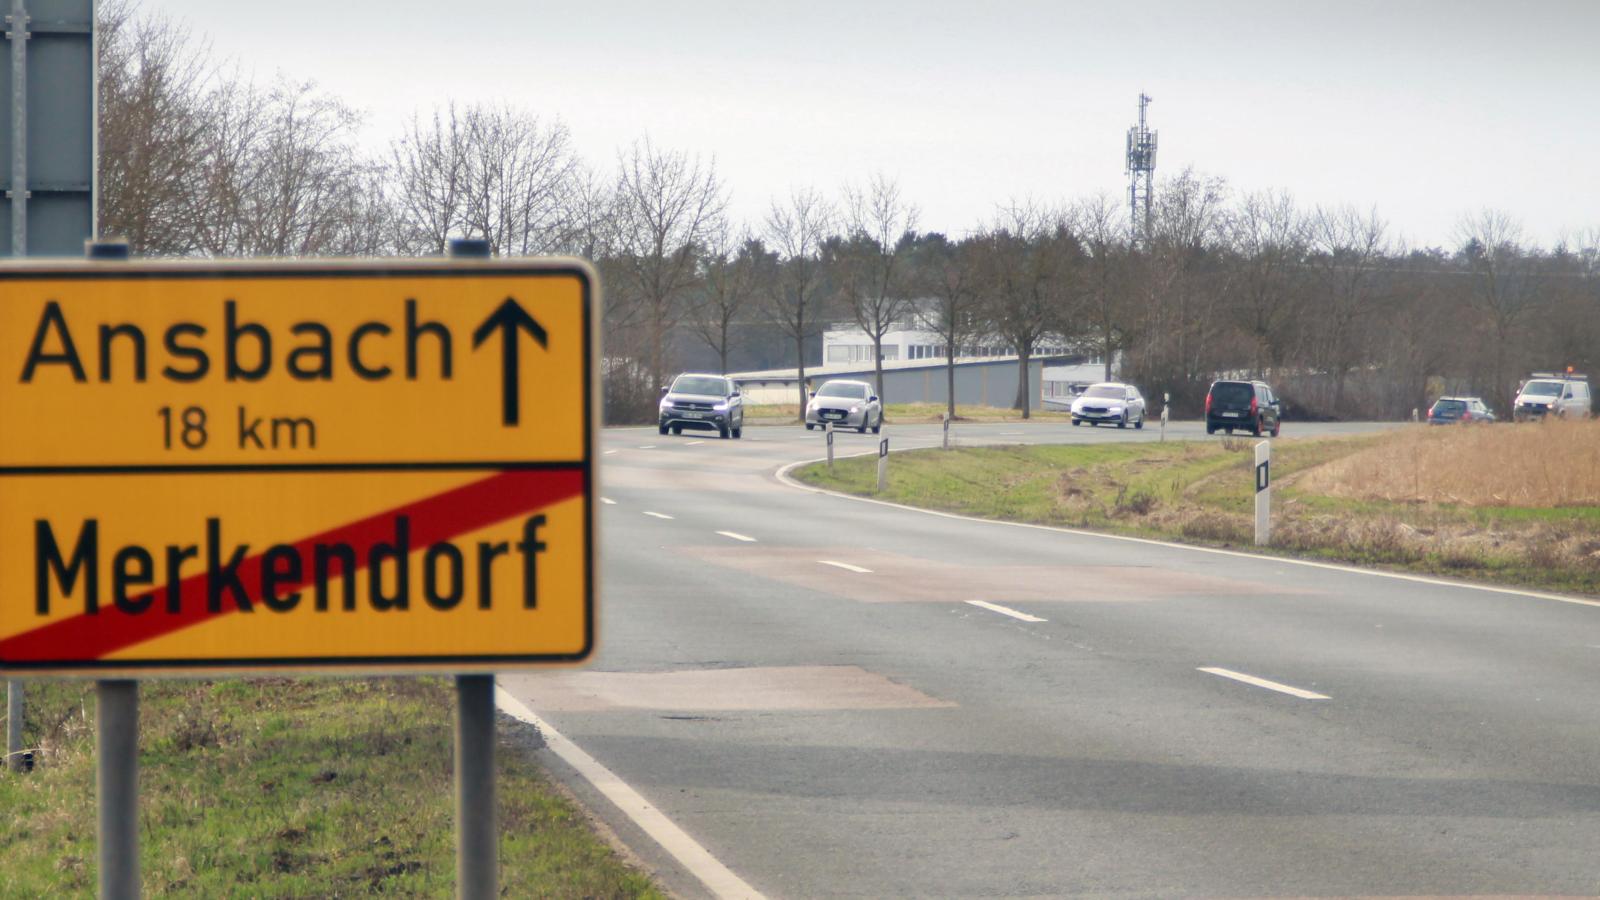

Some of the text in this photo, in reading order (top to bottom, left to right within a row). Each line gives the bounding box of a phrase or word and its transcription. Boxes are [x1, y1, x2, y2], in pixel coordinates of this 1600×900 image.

[20, 298, 453, 383] Ansbach
[160, 406, 315, 449] 18 km
[34, 513, 547, 616] Merkendorf
